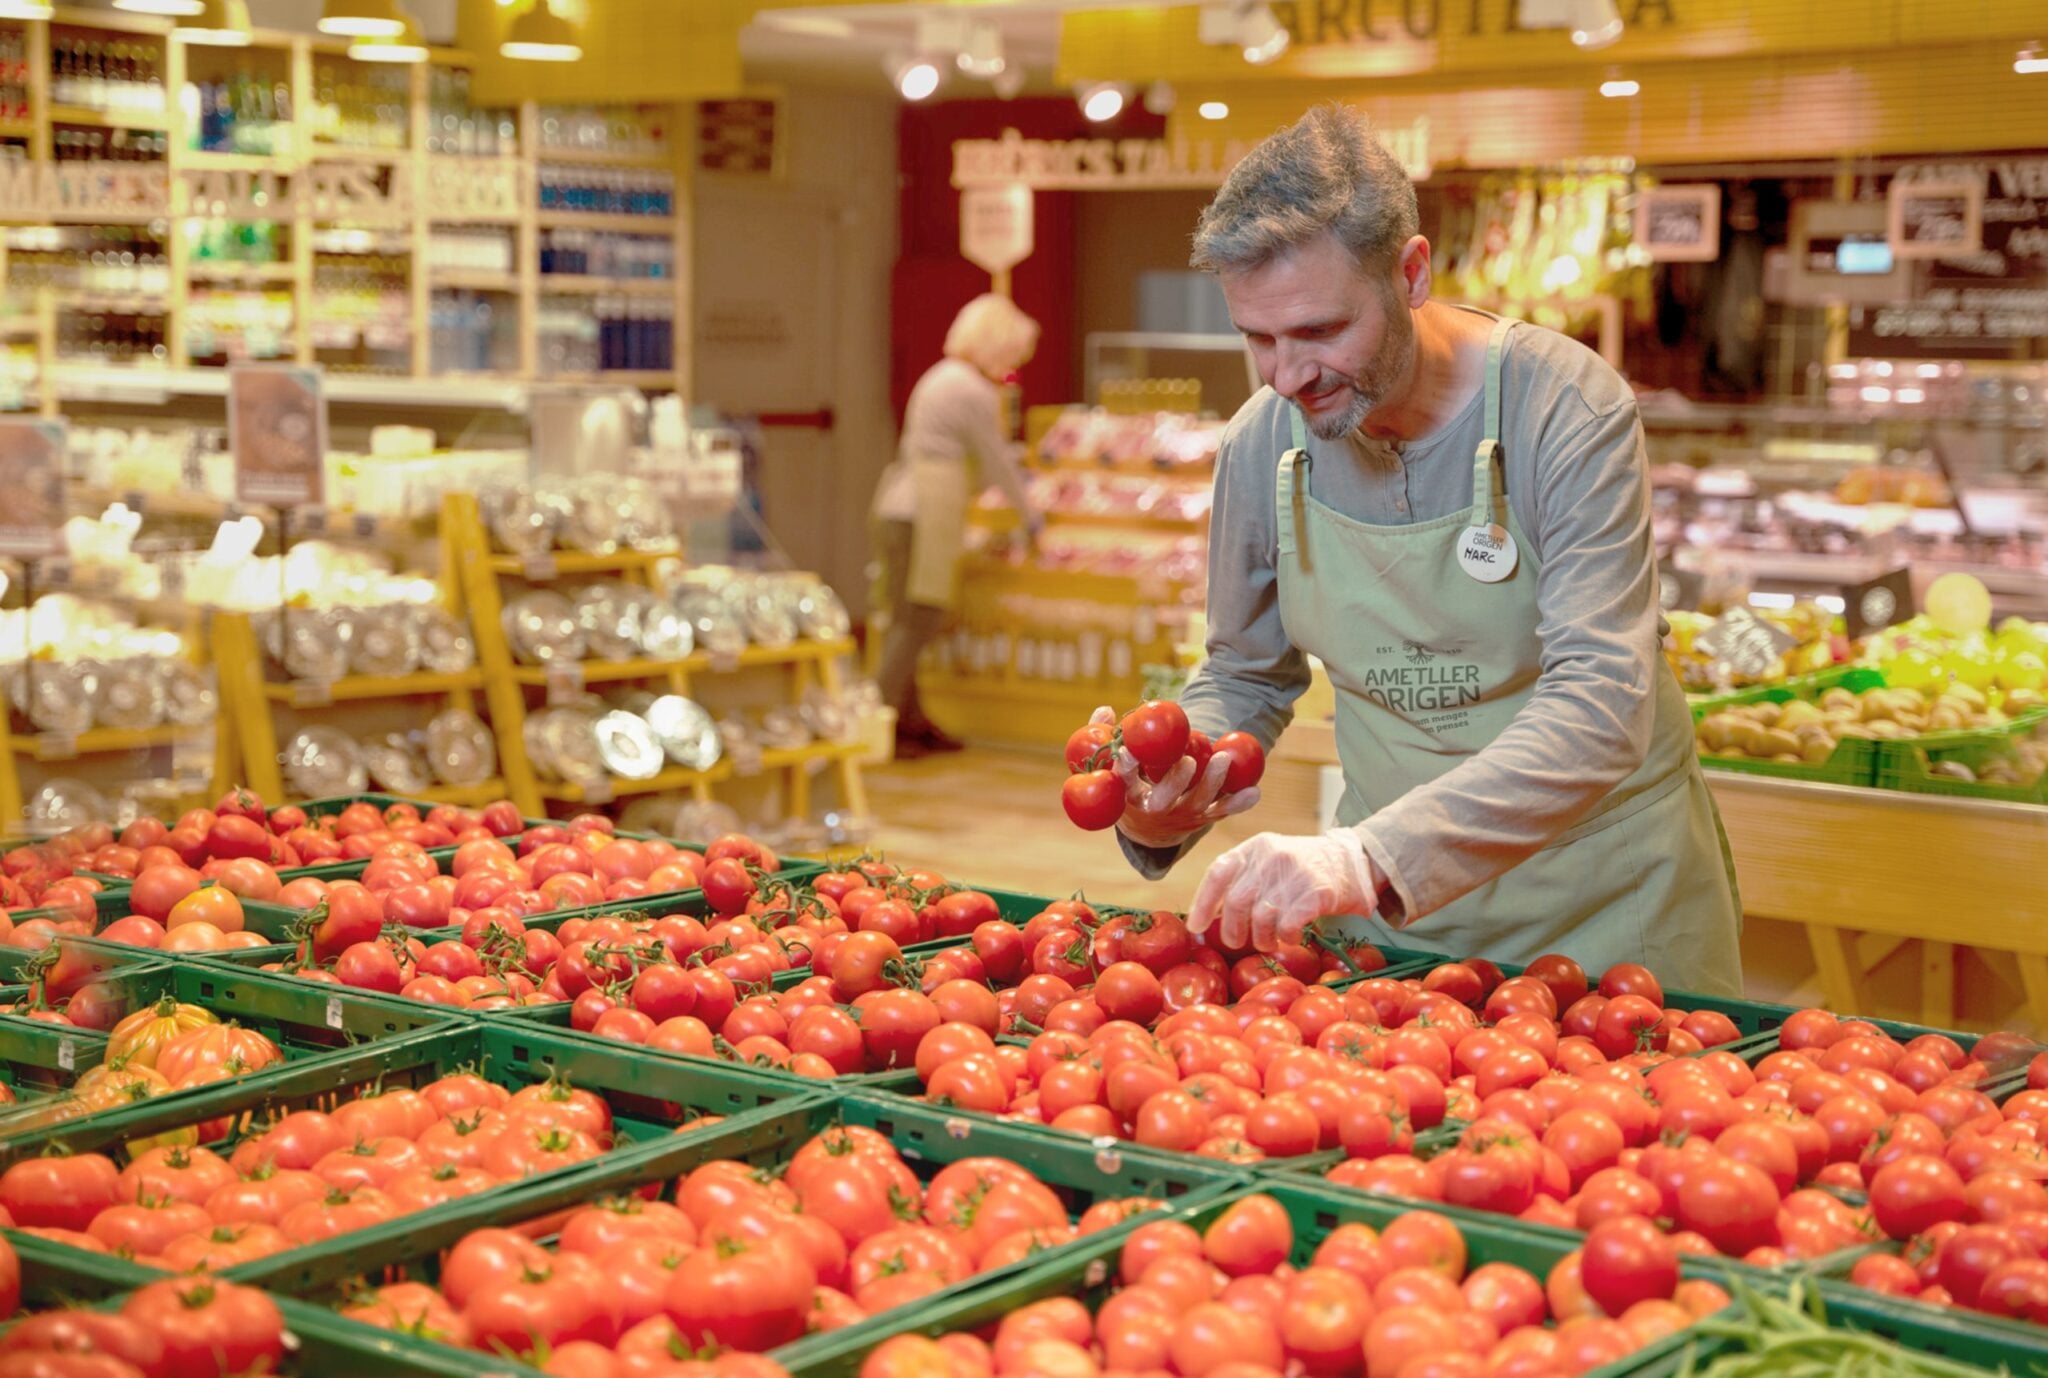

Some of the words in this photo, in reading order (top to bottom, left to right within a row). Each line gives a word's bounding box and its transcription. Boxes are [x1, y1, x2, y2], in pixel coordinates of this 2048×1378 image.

[1472, 537, 1503, 551] ORIGEN
[1464, 546, 1496, 563] MARC
[1376, 646, 1396, 654] EST.
[1365, 664, 1480, 687] AMETLLER
[1432, 710, 1469, 725] menges
[1436, 720, 1469, 734] penses
